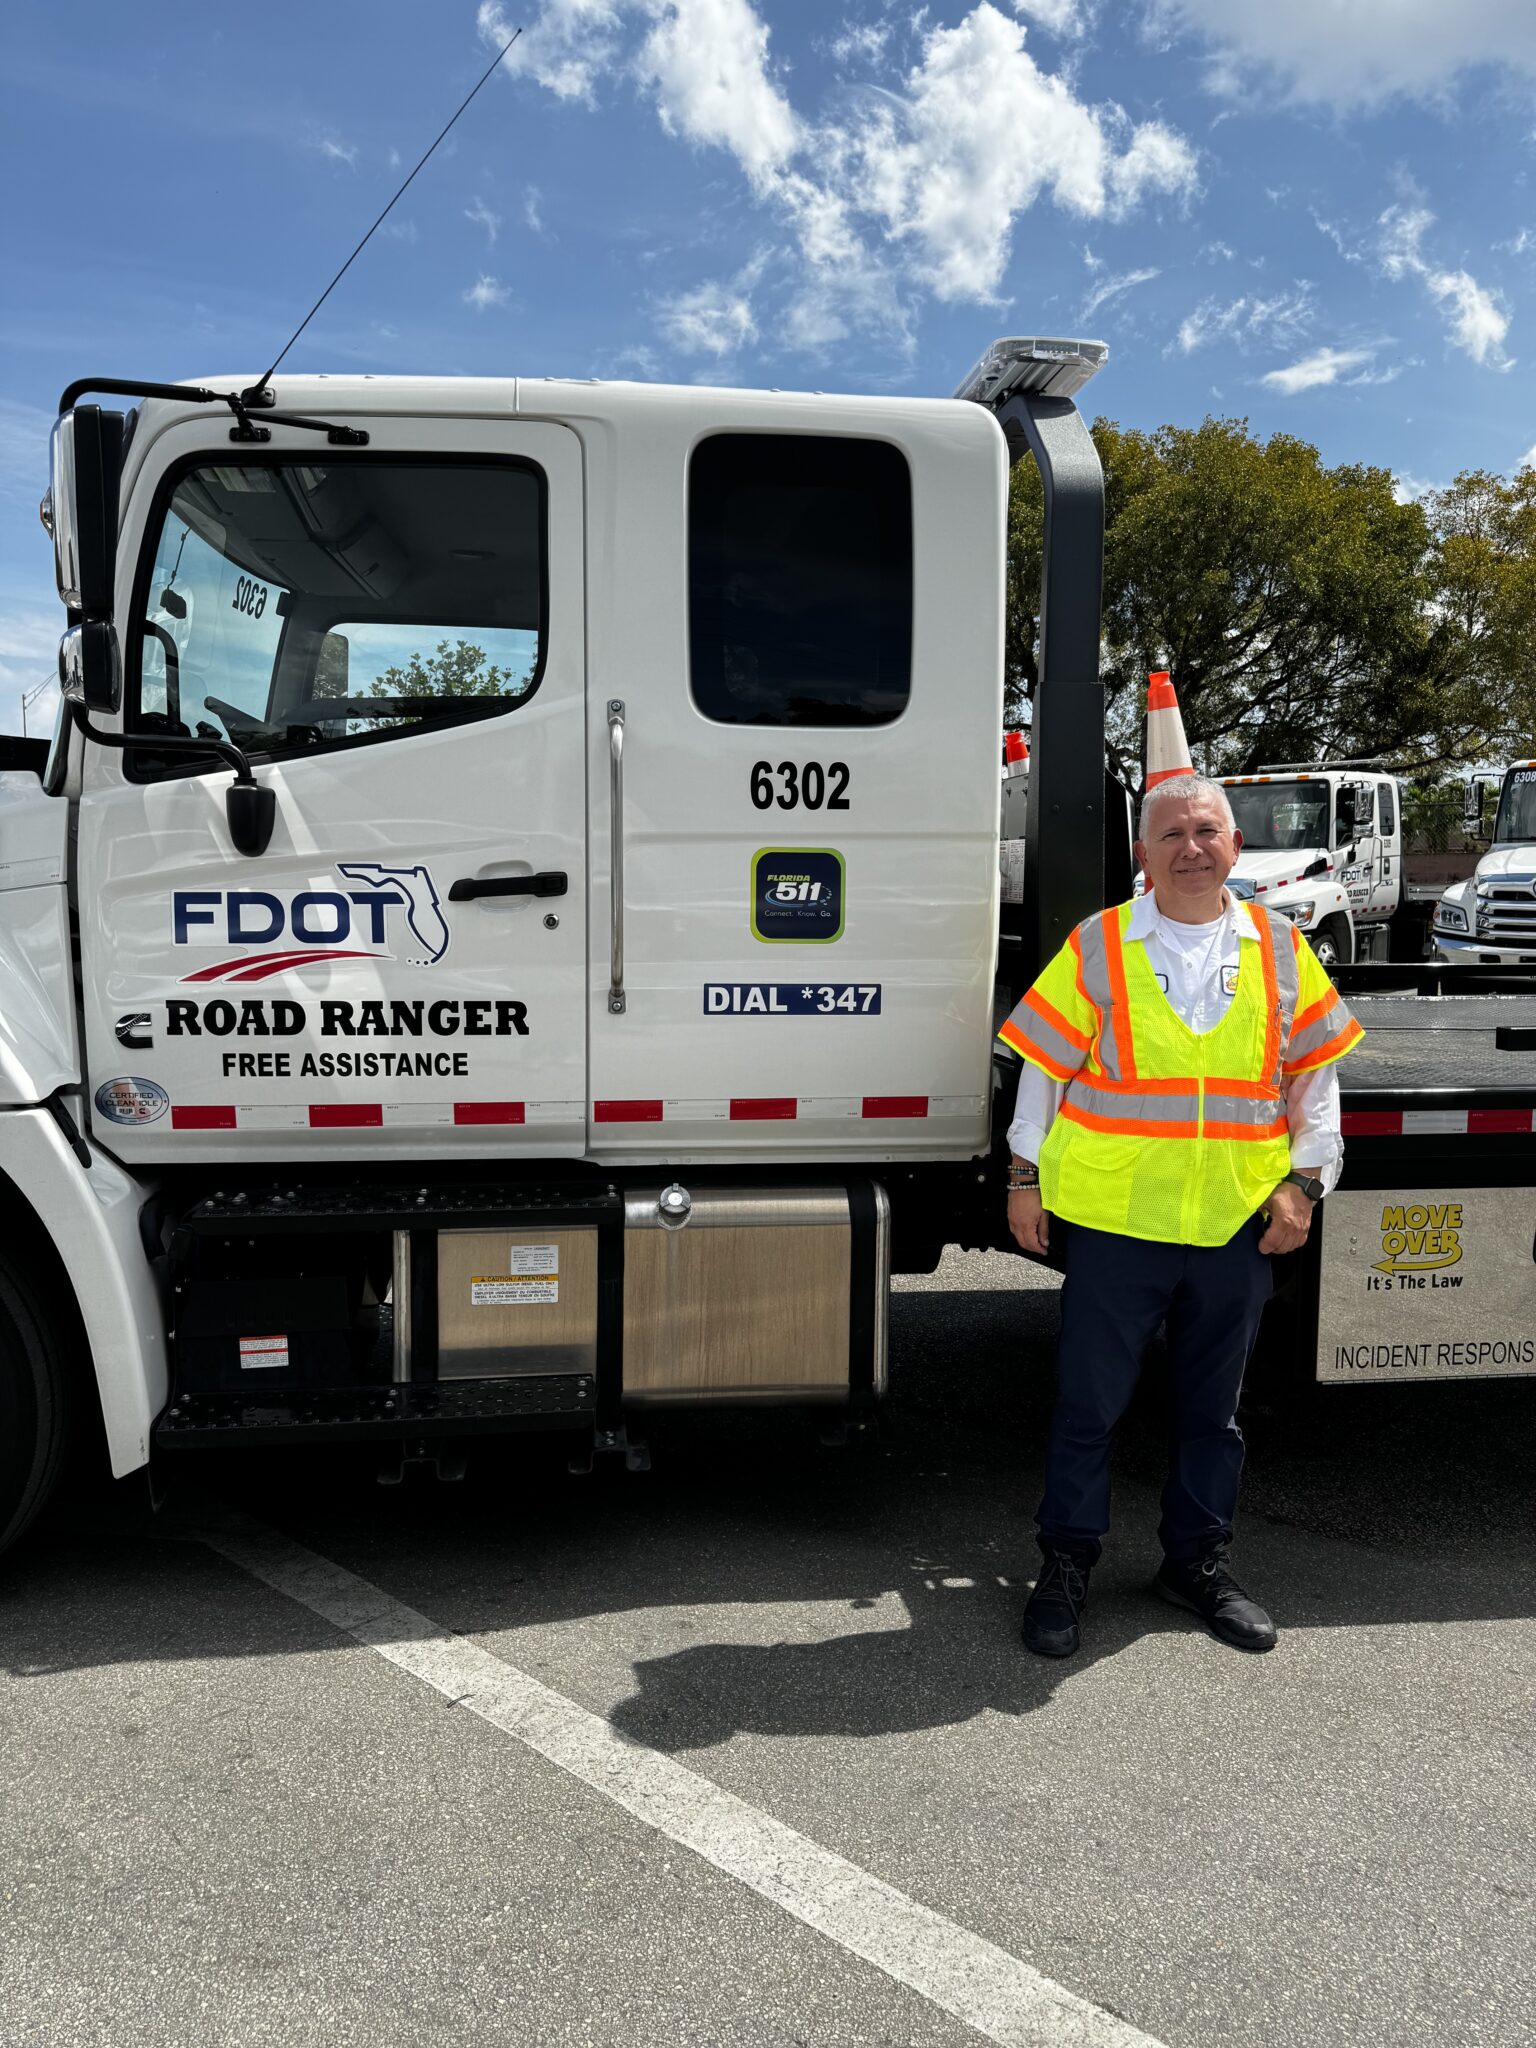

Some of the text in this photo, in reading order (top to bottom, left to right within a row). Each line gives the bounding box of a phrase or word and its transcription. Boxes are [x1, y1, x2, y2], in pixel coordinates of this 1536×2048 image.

[750, 761, 850, 811] 6302
[1514, 771, 1536, 783] 6308
[766, 874, 811, 882] FLORIDA
[775, 881, 822, 901] 511
[173, 891, 405, 944] FDOT
[707, 986, 788, 1012] DIAL
[165, 999, 530, 1036] ROAD RANGER
[222, 1052, 469, 1077] FREE ASSISTANCE
[105, 1099, 135, 1107] CLEAN
[1380, 1203, 1464, 1231] MOVE
[1381, 1229, 1463, 1258] OVER
[487, 1275, 513, 1283] CAUTION
[517, 1274, 549, 1282] ATTENTION
[1367, 1273, 1464, 1291] It's The Law
[1335, 1340, 1535, 1370] INCIDENT RESPONS
